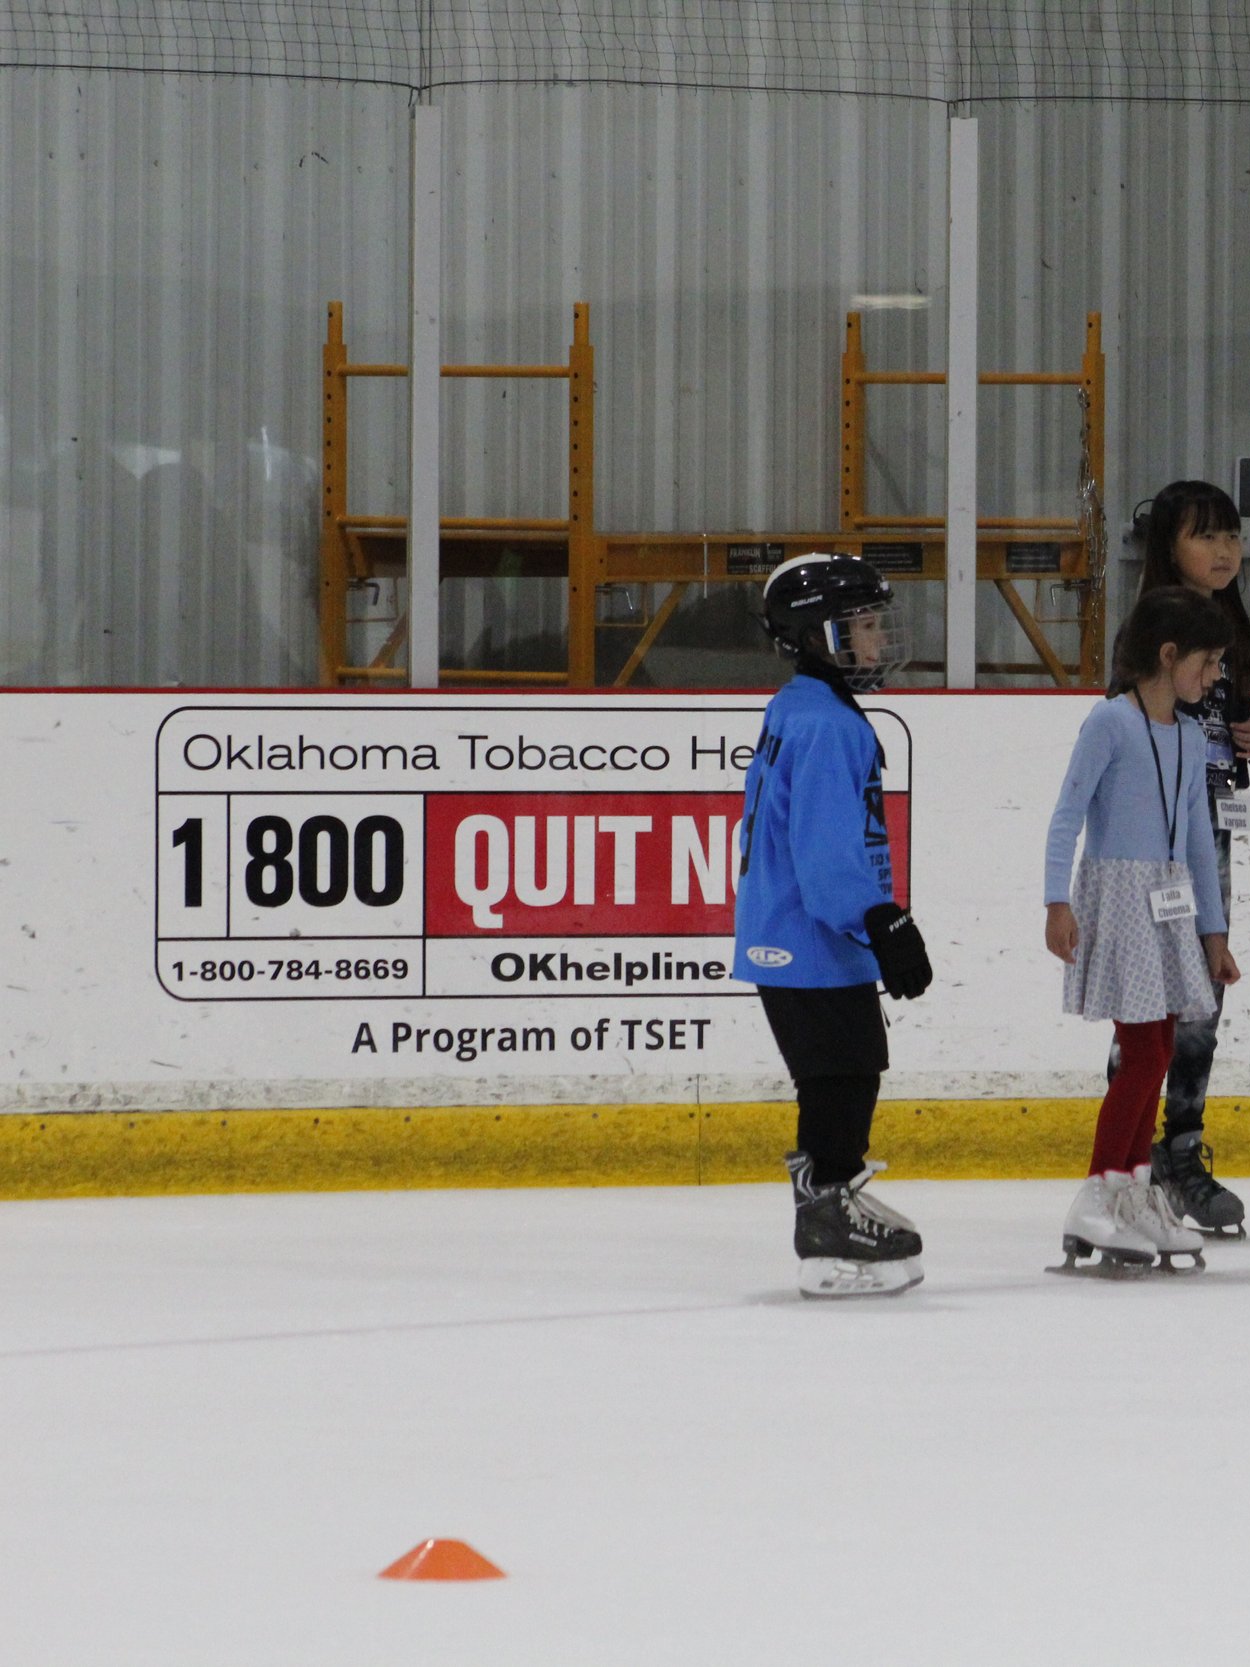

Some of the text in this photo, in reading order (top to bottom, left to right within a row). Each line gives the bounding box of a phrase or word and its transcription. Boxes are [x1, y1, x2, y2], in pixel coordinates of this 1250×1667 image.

[183, 734, 441, 771] Oklahoma
[458, 735, 670, 771] Tobacco
[691, 735, 756, 771] He
[172, 814, 405, 908] 1 800
[454, 813, 744, 929] QUIT N
[172, 959, 409, 982] 1-800-784-8669
[490, 952, 734, 986] OKhelpline.
[351, 1018, 711, 1062] A Program of TSET
